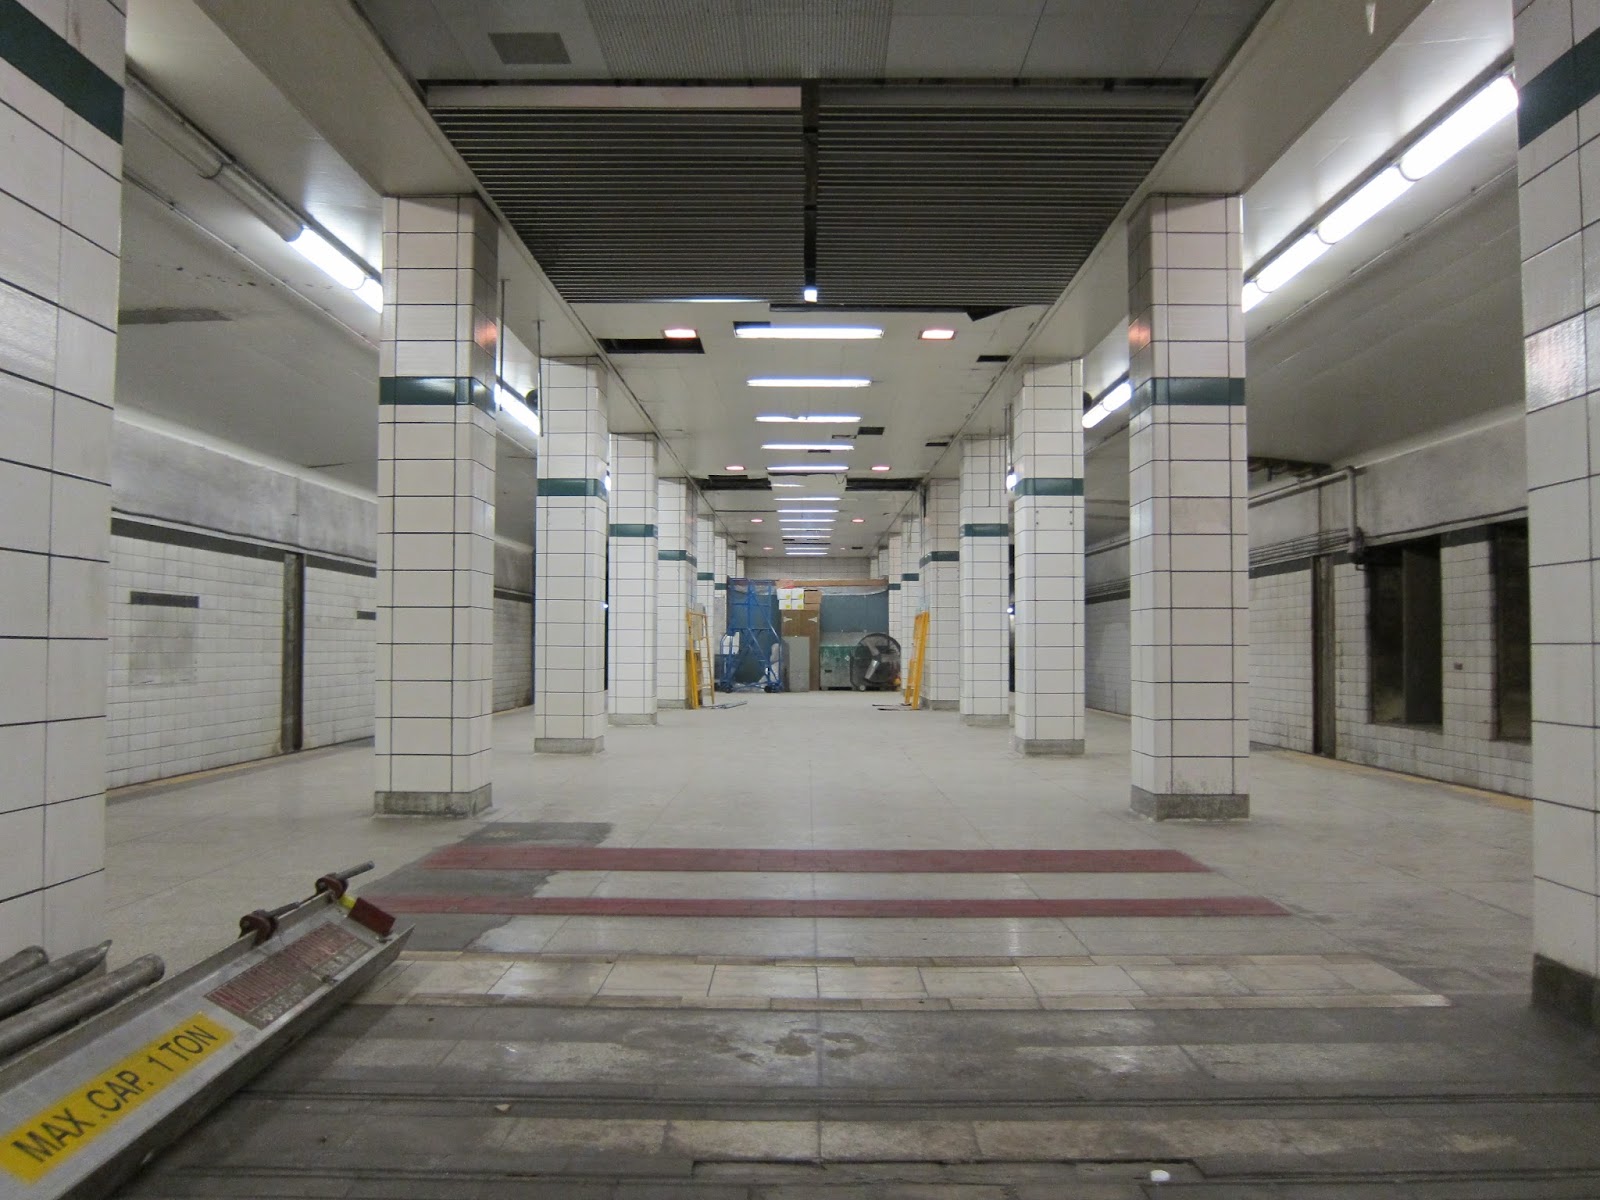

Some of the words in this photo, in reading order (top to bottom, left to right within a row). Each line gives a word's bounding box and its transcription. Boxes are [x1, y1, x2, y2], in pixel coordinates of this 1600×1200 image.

[159, 1024, 219, 1061] TON
[148, 1055, 173, 1072] 1
[12, 1108, 96, 1163] MAX
